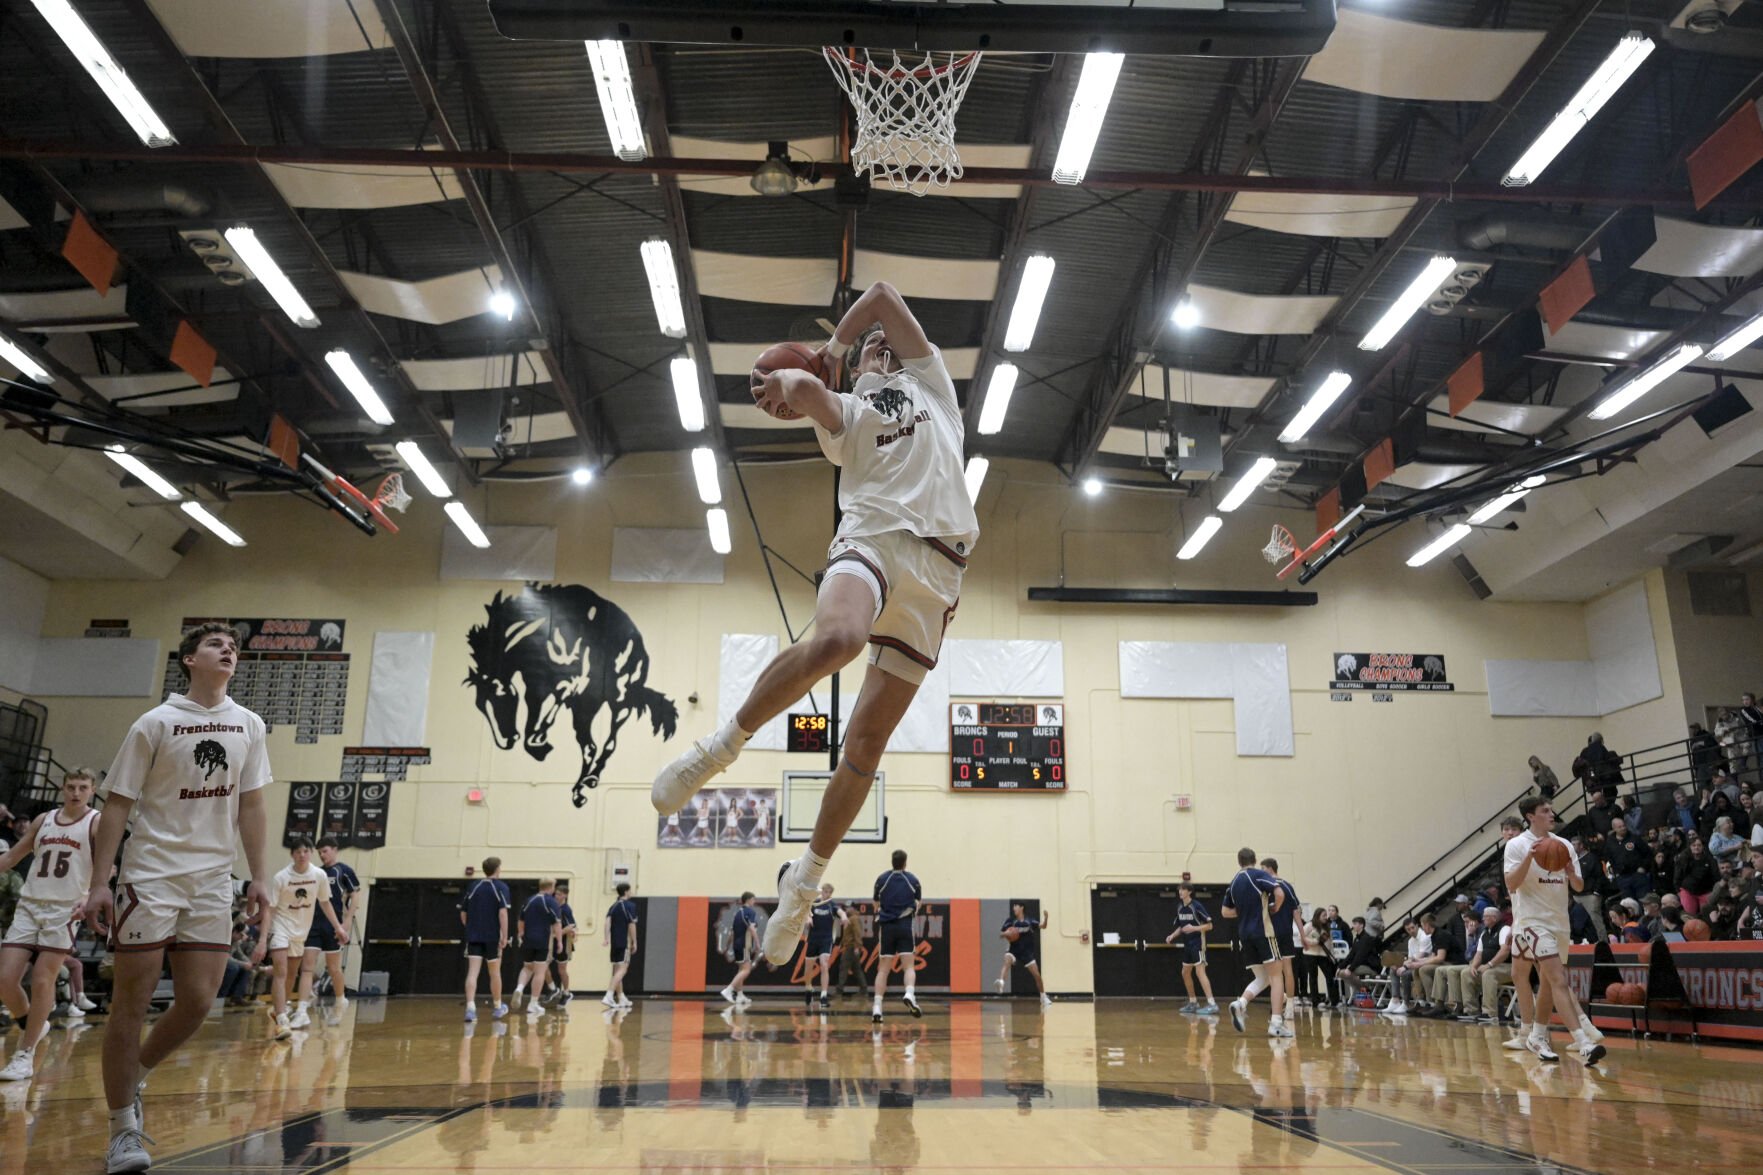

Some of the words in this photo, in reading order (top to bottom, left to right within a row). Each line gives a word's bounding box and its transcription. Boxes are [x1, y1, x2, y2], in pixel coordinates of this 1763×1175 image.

[875, 409, 931, 447] Baskeall
[1359, 666, 1424, 682] CHAMPIONS
[173, 722, 244, 736] Frenchtown
[795, 716, 826, 729] 12:58
[953, 726, 988, 736] BRONCS
[1032, 727, 1060, 736] GUEST
[973, 738, 984, 756] 0
[1050, 739, 1060, 757] 0
[989, 757, 1010, 765] PLAYER
[1012, 757, 1028, 765] FOUL
[960, 765, 969, 779] 0
[1052, 765, 1061, 780] 0
[37, 849, 72, 878] 15
